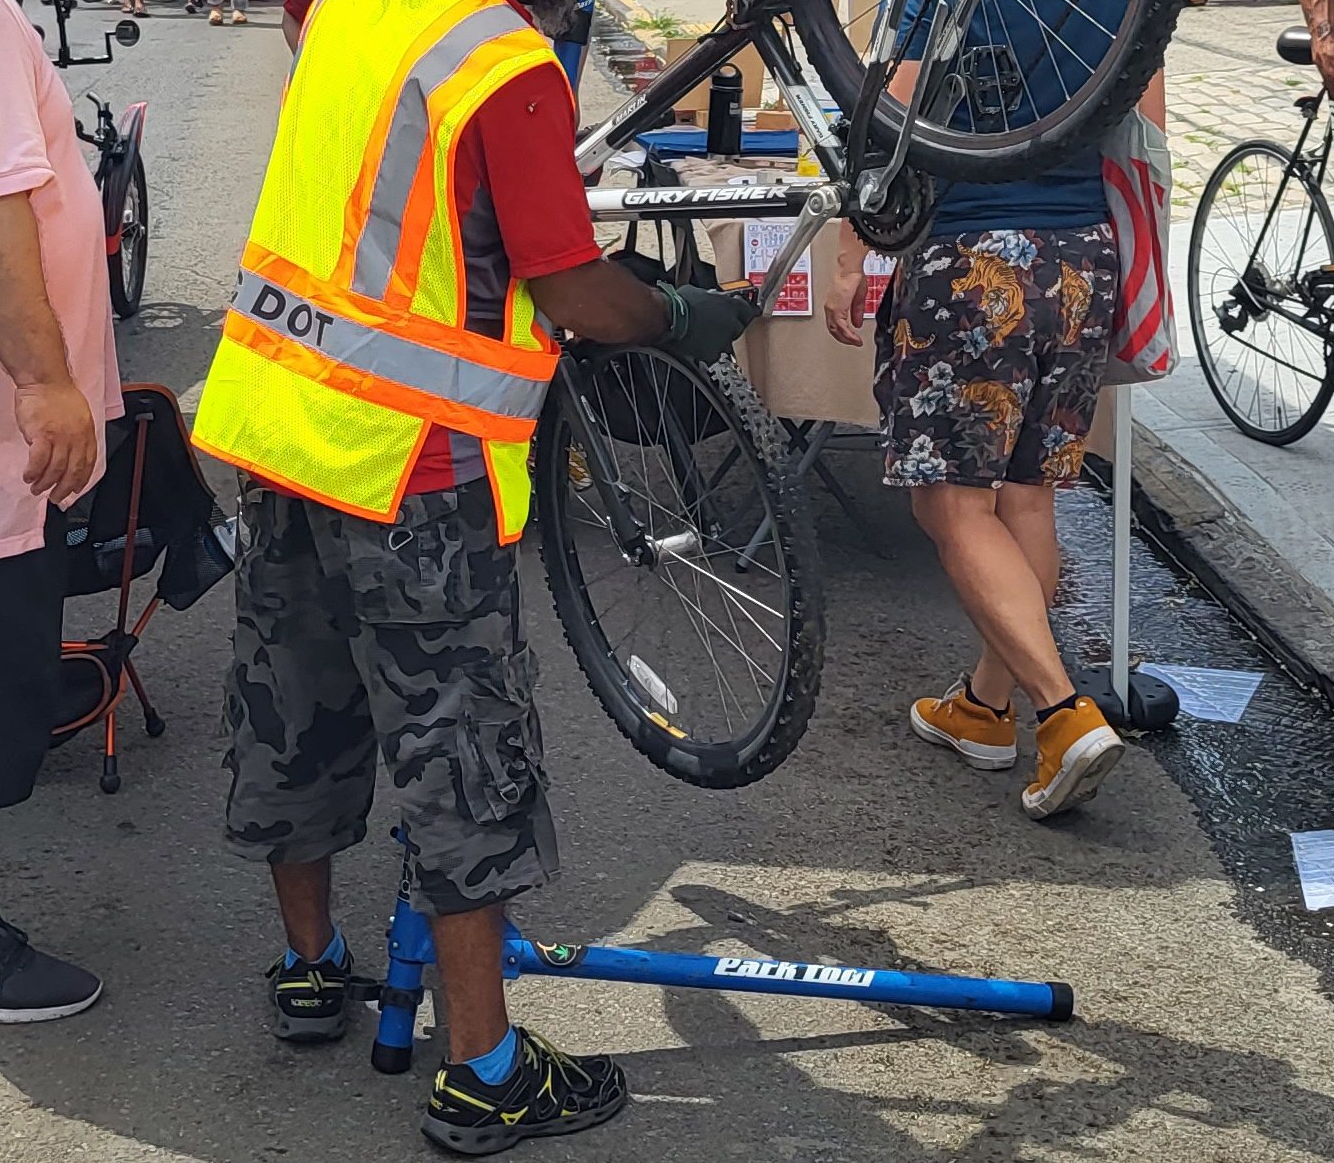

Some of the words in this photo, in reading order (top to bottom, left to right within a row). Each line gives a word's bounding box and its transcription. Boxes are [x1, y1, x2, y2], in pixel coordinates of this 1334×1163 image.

[624, 189, 695, 205] GARY
[692, 185, 790, 202] FISHER
[250, 284, 334, 347] DOT
[714, 957, 798, 981] Park
